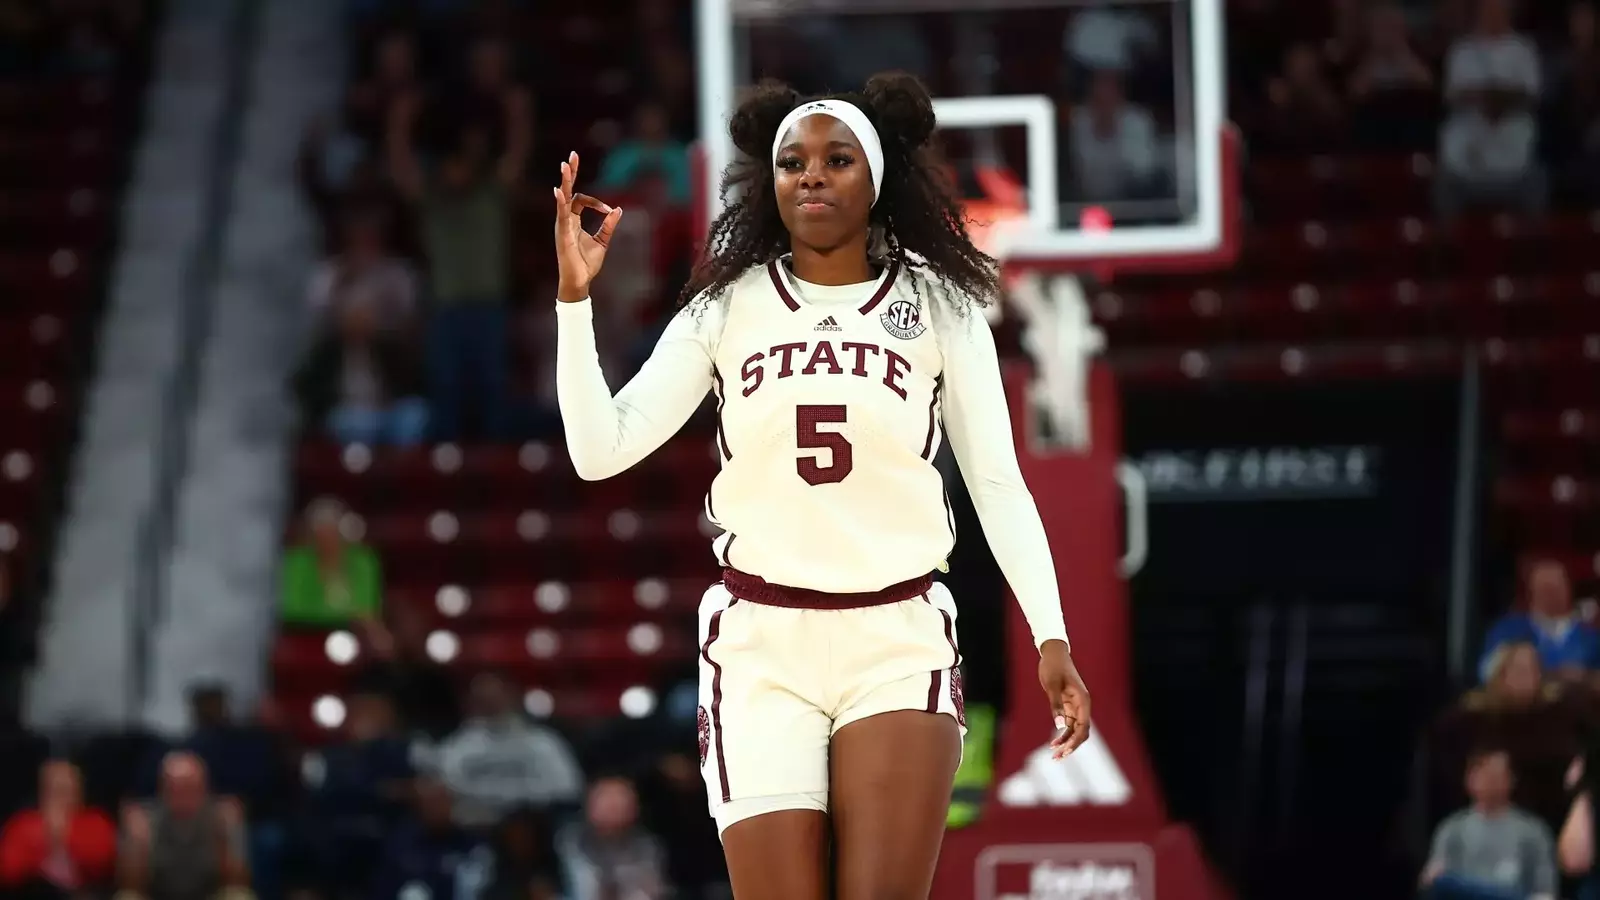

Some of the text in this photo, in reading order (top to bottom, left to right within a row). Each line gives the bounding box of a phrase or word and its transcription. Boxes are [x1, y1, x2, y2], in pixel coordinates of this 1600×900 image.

[883, 320, 917, 338] GRADUATE
[889, 301, 918, 330] SEC
[741, 341, 912, 401] STATE
[796, 404, 853, 486] 5
